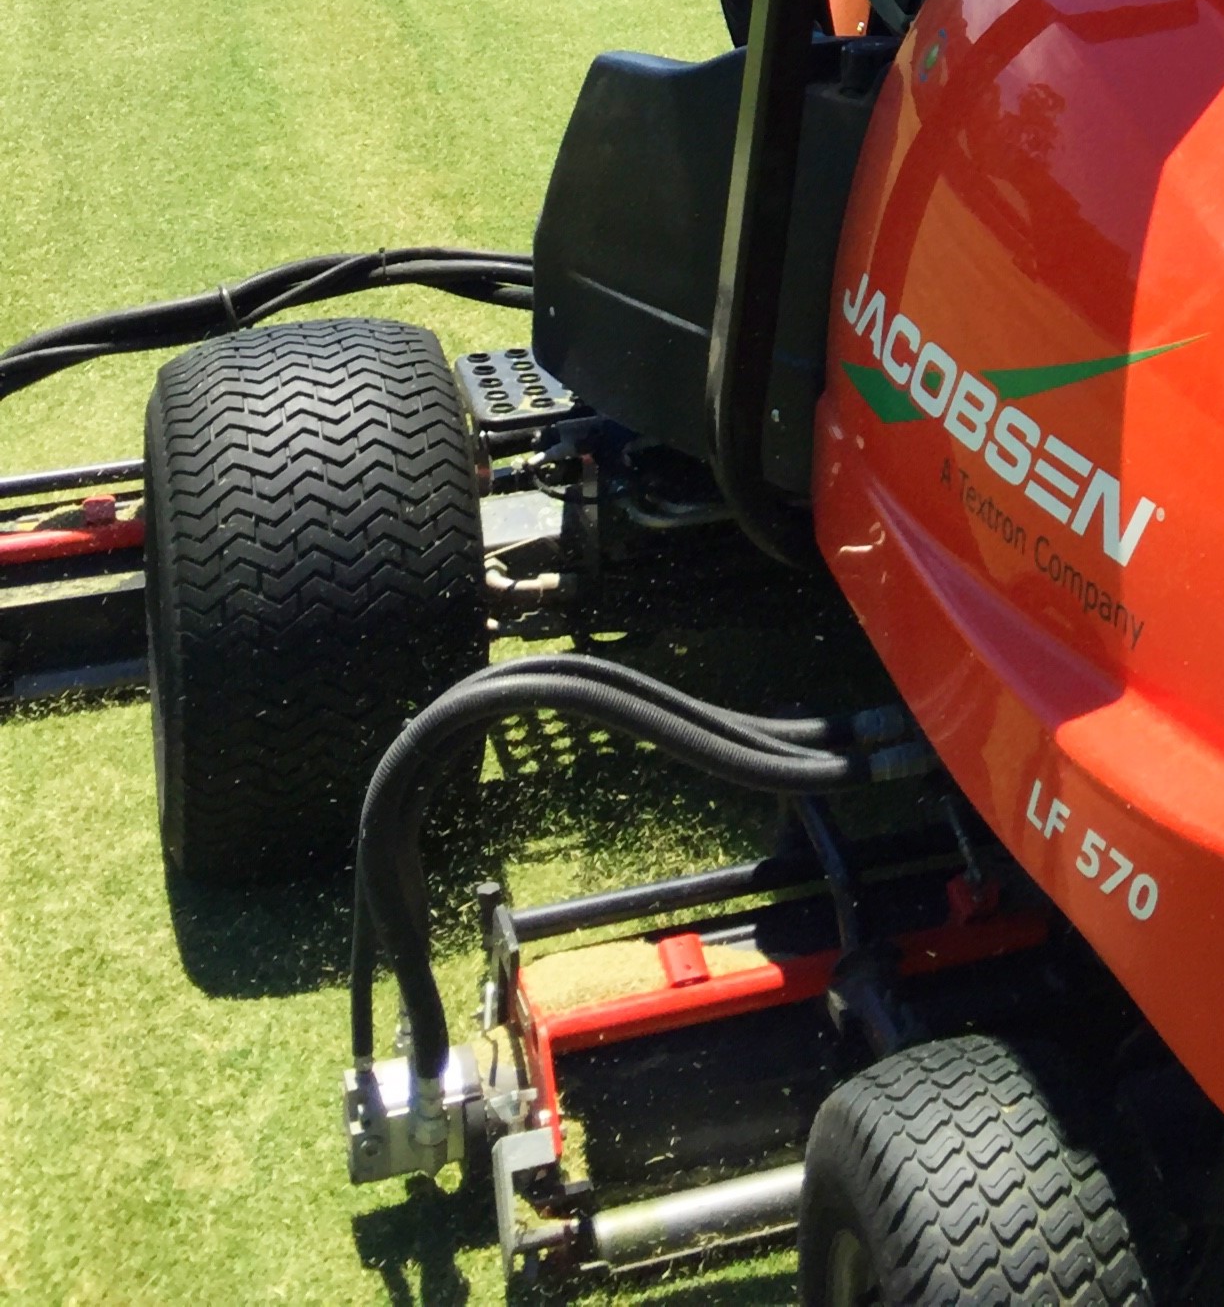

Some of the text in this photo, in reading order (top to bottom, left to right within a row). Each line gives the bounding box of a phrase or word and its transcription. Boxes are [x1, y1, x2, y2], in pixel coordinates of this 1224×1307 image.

[843, 273, 1157, 567] JACOBSEN
[940, 458, 1145, 650] A Textron Company
[1026, 778, 1158, 921] LF 570
